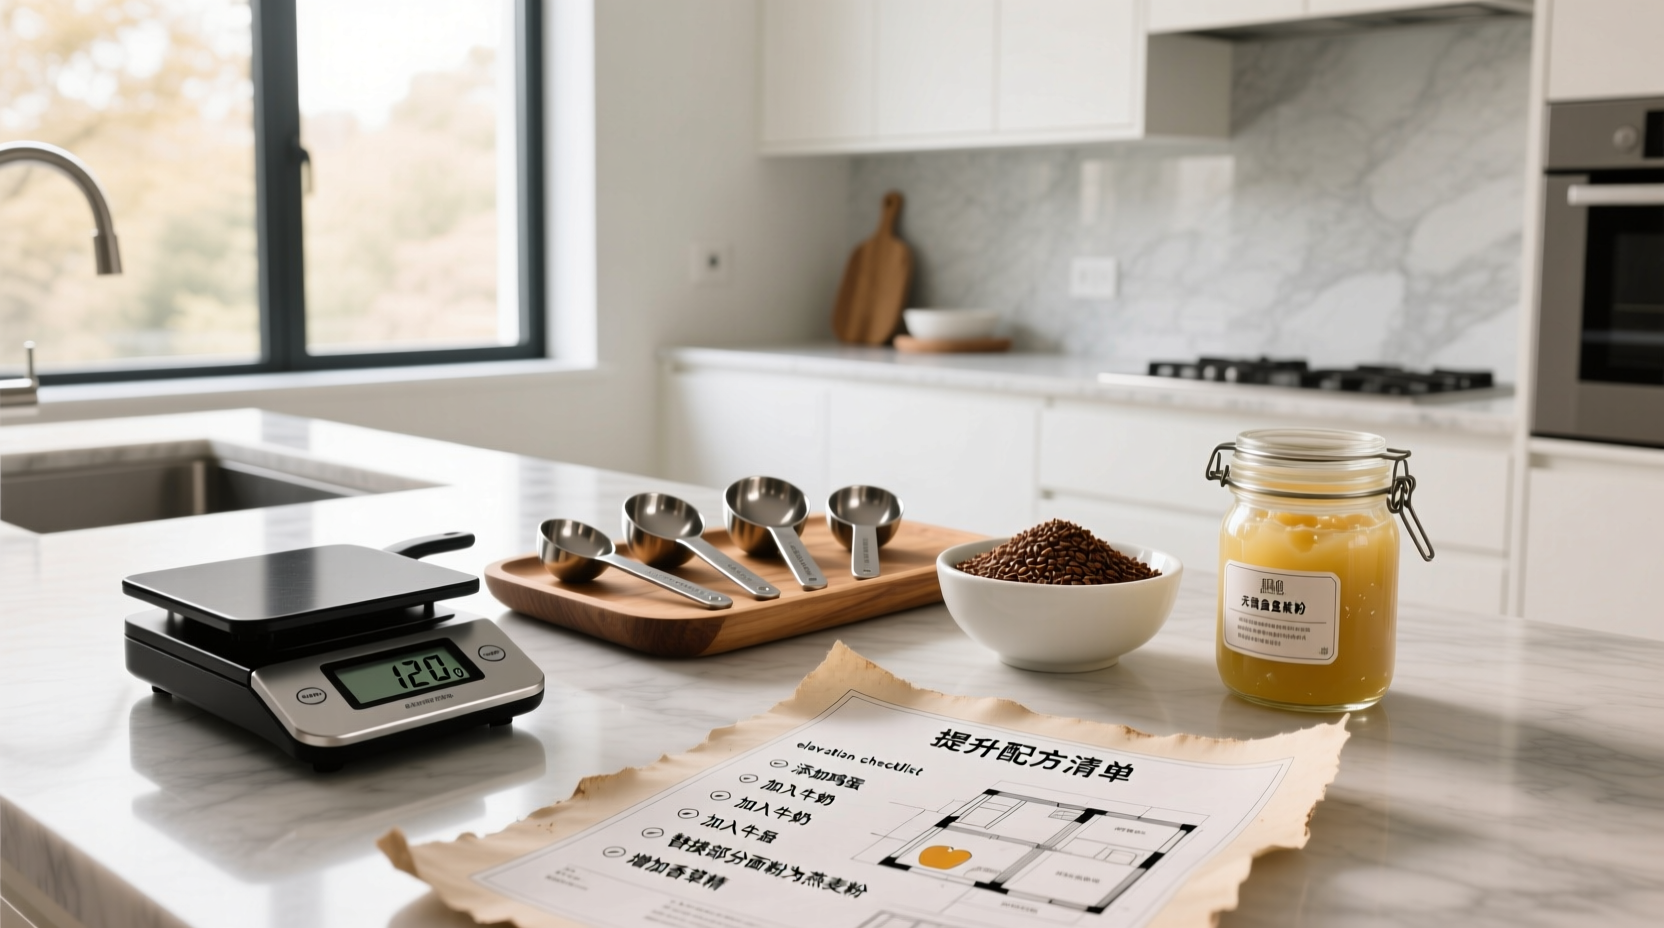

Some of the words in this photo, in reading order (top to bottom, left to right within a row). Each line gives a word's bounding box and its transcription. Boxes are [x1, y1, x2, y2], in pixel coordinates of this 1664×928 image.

[392, 654, 451, 689] 120
[930, 728, 1135, 783] 提升配方清单
